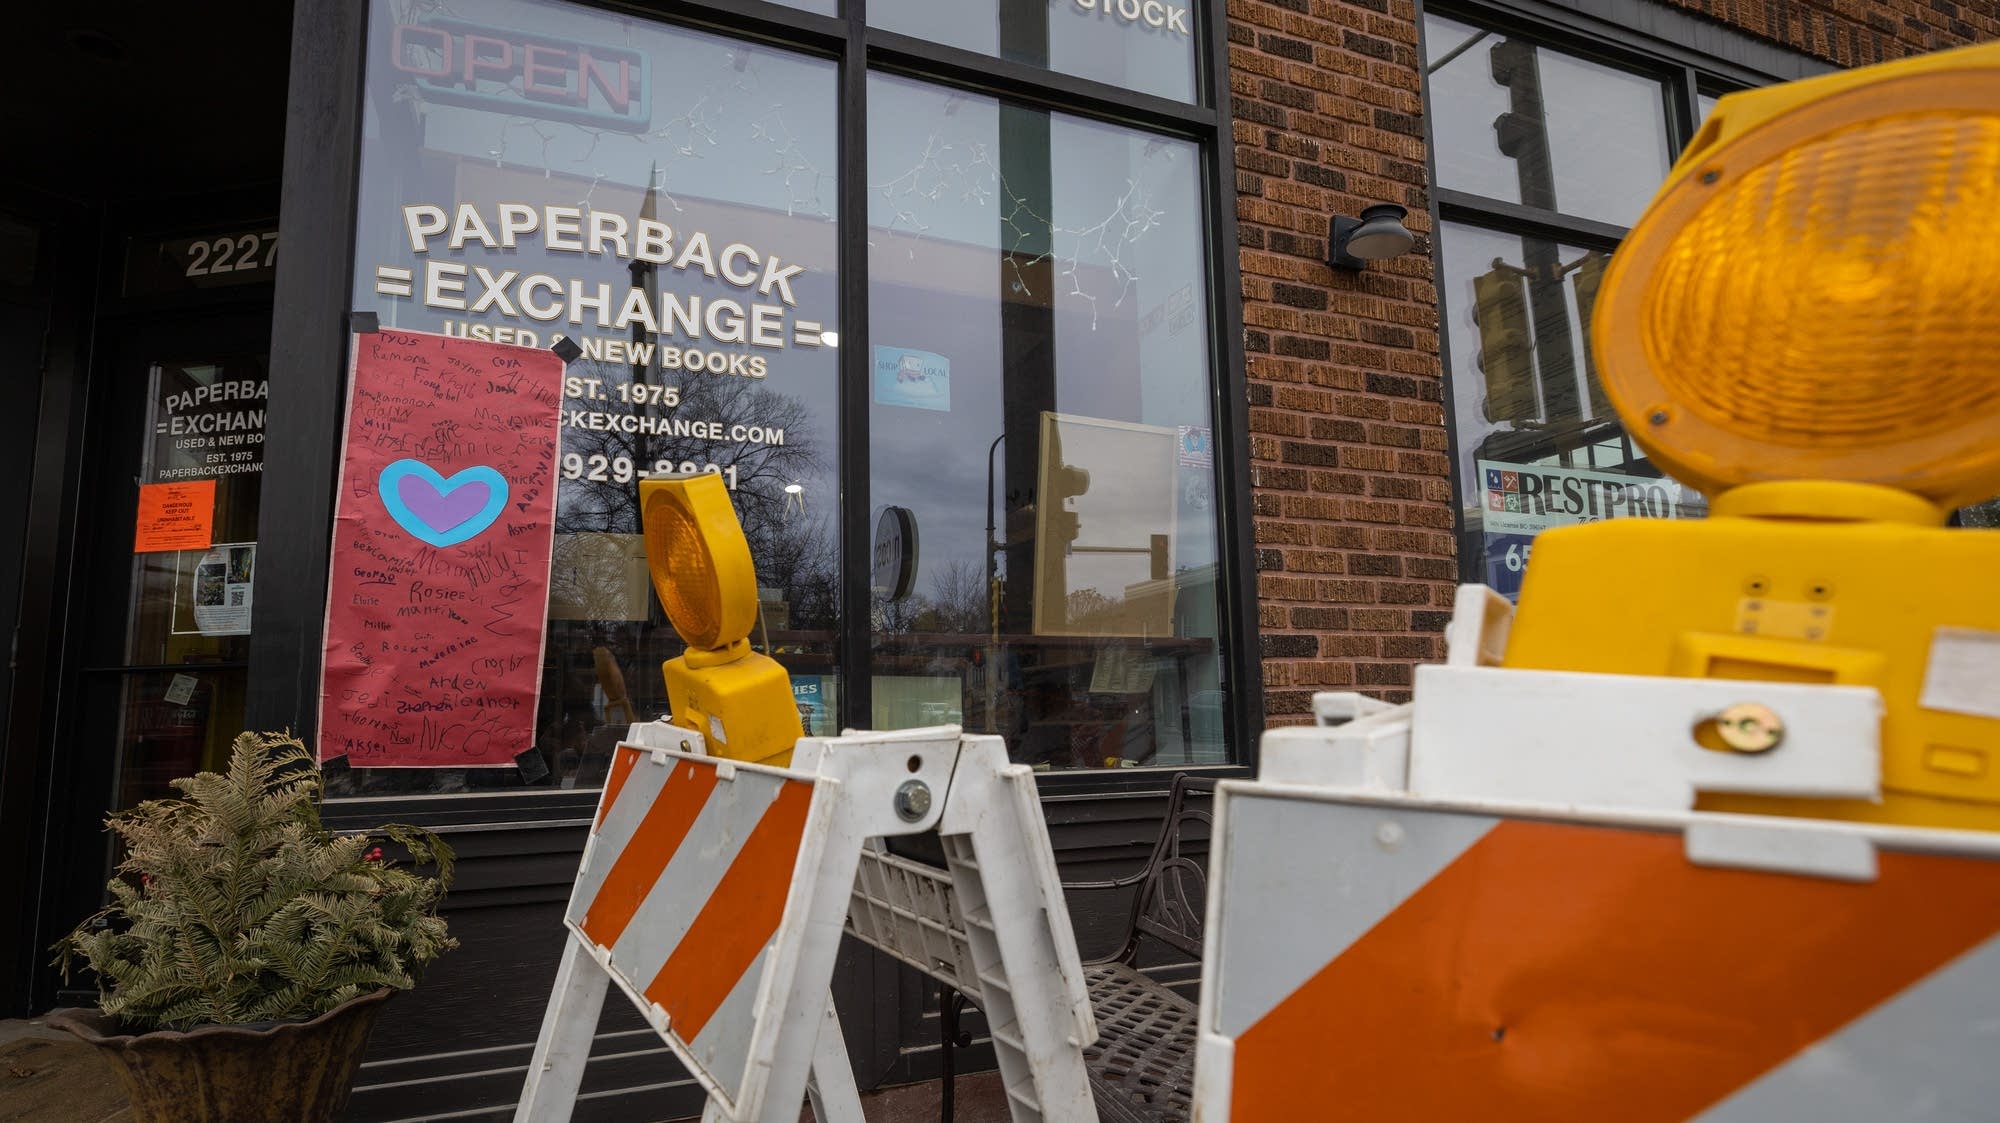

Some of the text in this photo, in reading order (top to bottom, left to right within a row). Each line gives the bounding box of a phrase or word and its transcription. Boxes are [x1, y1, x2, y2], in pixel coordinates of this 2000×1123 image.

[392, 24, 630, 112] OPEN
[186, 232, 279, 276] 2227
[402, 202, 805, 305] PAPERBACK
[579, 337, 656, 367] NEW
[661, 346, 768, 379] BOOKS
[165, 380, 269, 415] PAPERBA
[565, 376, 680, 407] ST. 1975
[175, 438, 206, 449] USED
[208, 437, 216, 447] &
[219, 434, 245, 446] NEW
[561, 410, 785, 446] CKEXCHANGE.COM
[206, 451, 253, 463] EST. 1975
[1518, 471, 1671, 520] RESTPRO
[793, 684, 818, 695] IES
